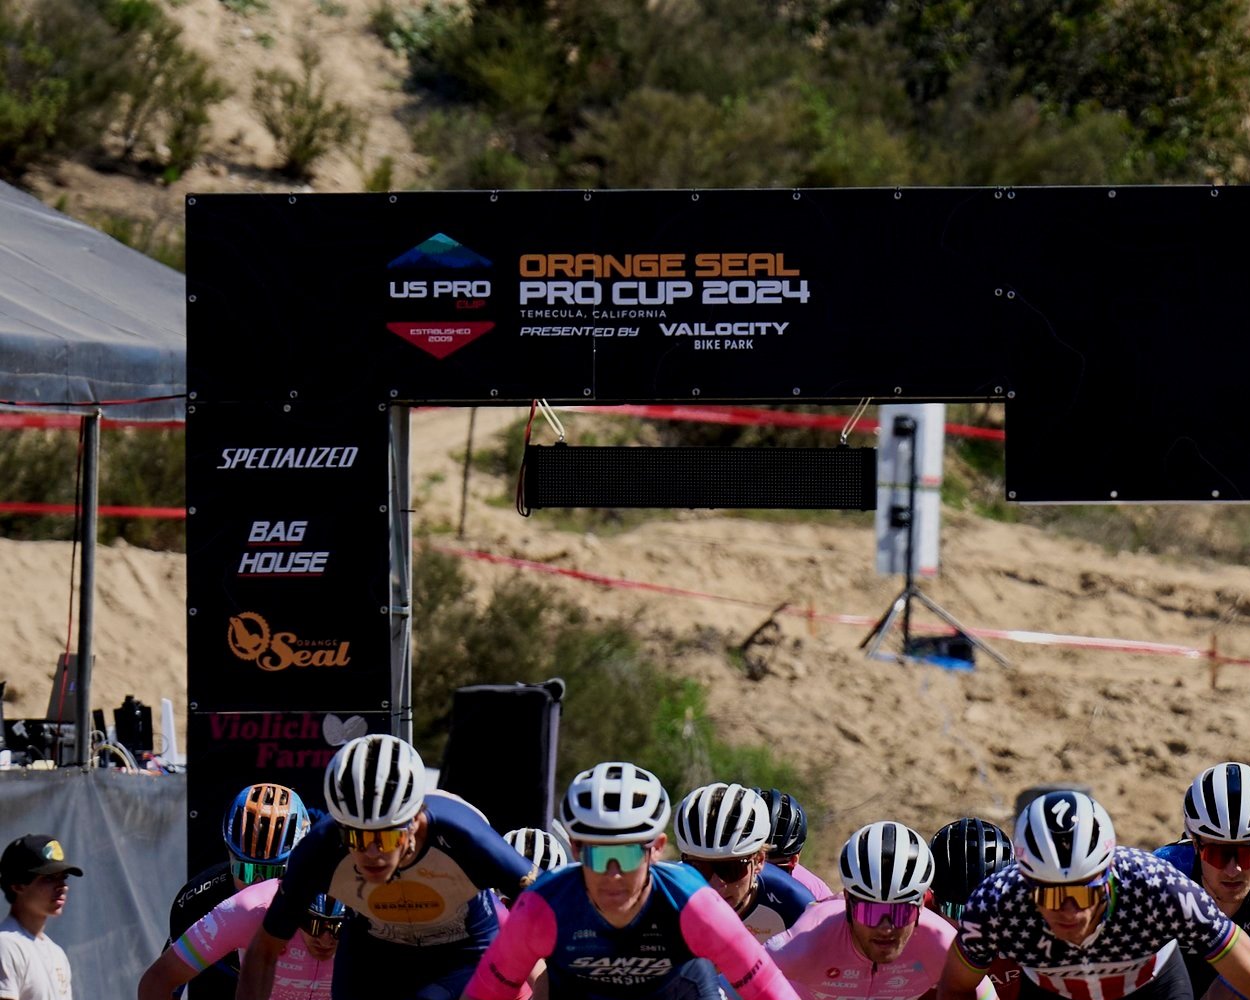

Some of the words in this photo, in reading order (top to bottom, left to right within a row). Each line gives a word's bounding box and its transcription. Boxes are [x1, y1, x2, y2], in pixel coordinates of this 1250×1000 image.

[519, 254, 686, 278] ORANGE
[695, 253, 800, 277] SEAL
[390, 281, 427, 298] US
[433, 280, 491, 298] PRO
[519, 281, 602, 305] PRO
[612, 281, 693, 305] CUP
[702, 280, 810, 304] 2024
[456, 300, 486, 310] CUP
[520, 310, 587, 319] TEMECULA,
[591, 309, 667, 319] CALIFORNIA
[410, 328, 471, 336] ESTABLISHED
[520, 326, 615, 338] PRESENTED
[617, 326, 640, 337] BY
[659, 322, 790, 337] VAILOCITY
[694, 339, 721, 350] BIKE
[724, 339, 754, 350] PARK
[216, 446, 359, 469] SPECIALIZED
[247, 520, 309, 543] BAG
[237, 551, 330, 574] HOUSE
[256, 632, 351, 671] Seal
[296, 639, 337, 647] ORANGE
[208, 712, 320, 740] Violich
[255, 742, 337, 769] Farm
[568, 956, 673, 968] SANTA
